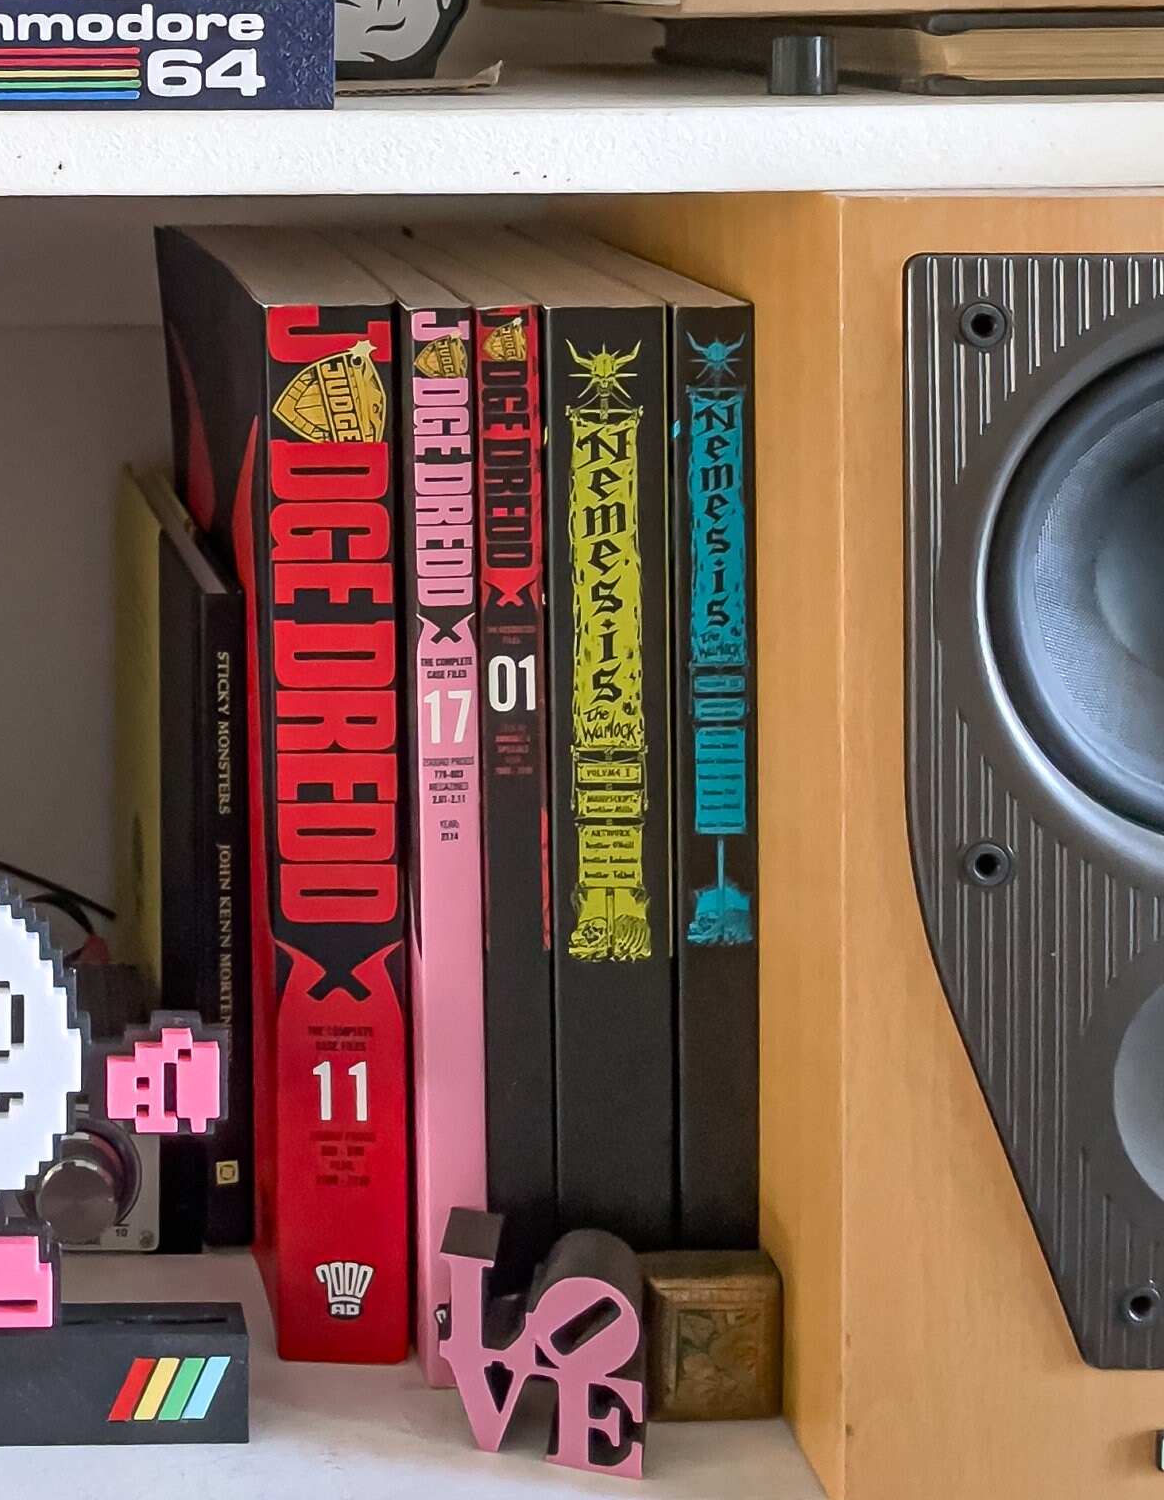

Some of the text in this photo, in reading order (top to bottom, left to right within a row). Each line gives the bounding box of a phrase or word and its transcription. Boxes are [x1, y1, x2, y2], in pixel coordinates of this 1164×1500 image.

[146, 48, 266, 97] 64
[693, 401, 735, 628] Nemesis
[575, 426, 632, 704] Nemesis
[488, 655, 535, 712] 01
[423, 689, 472, 744] 17
[584, 706, 609, 722] The
[216, 652, 231, 948] STICKY MONSTERS JOHN KENN
[274, 620, 398, 924] DREDD
[312, 1061, 368, 1121] 11
